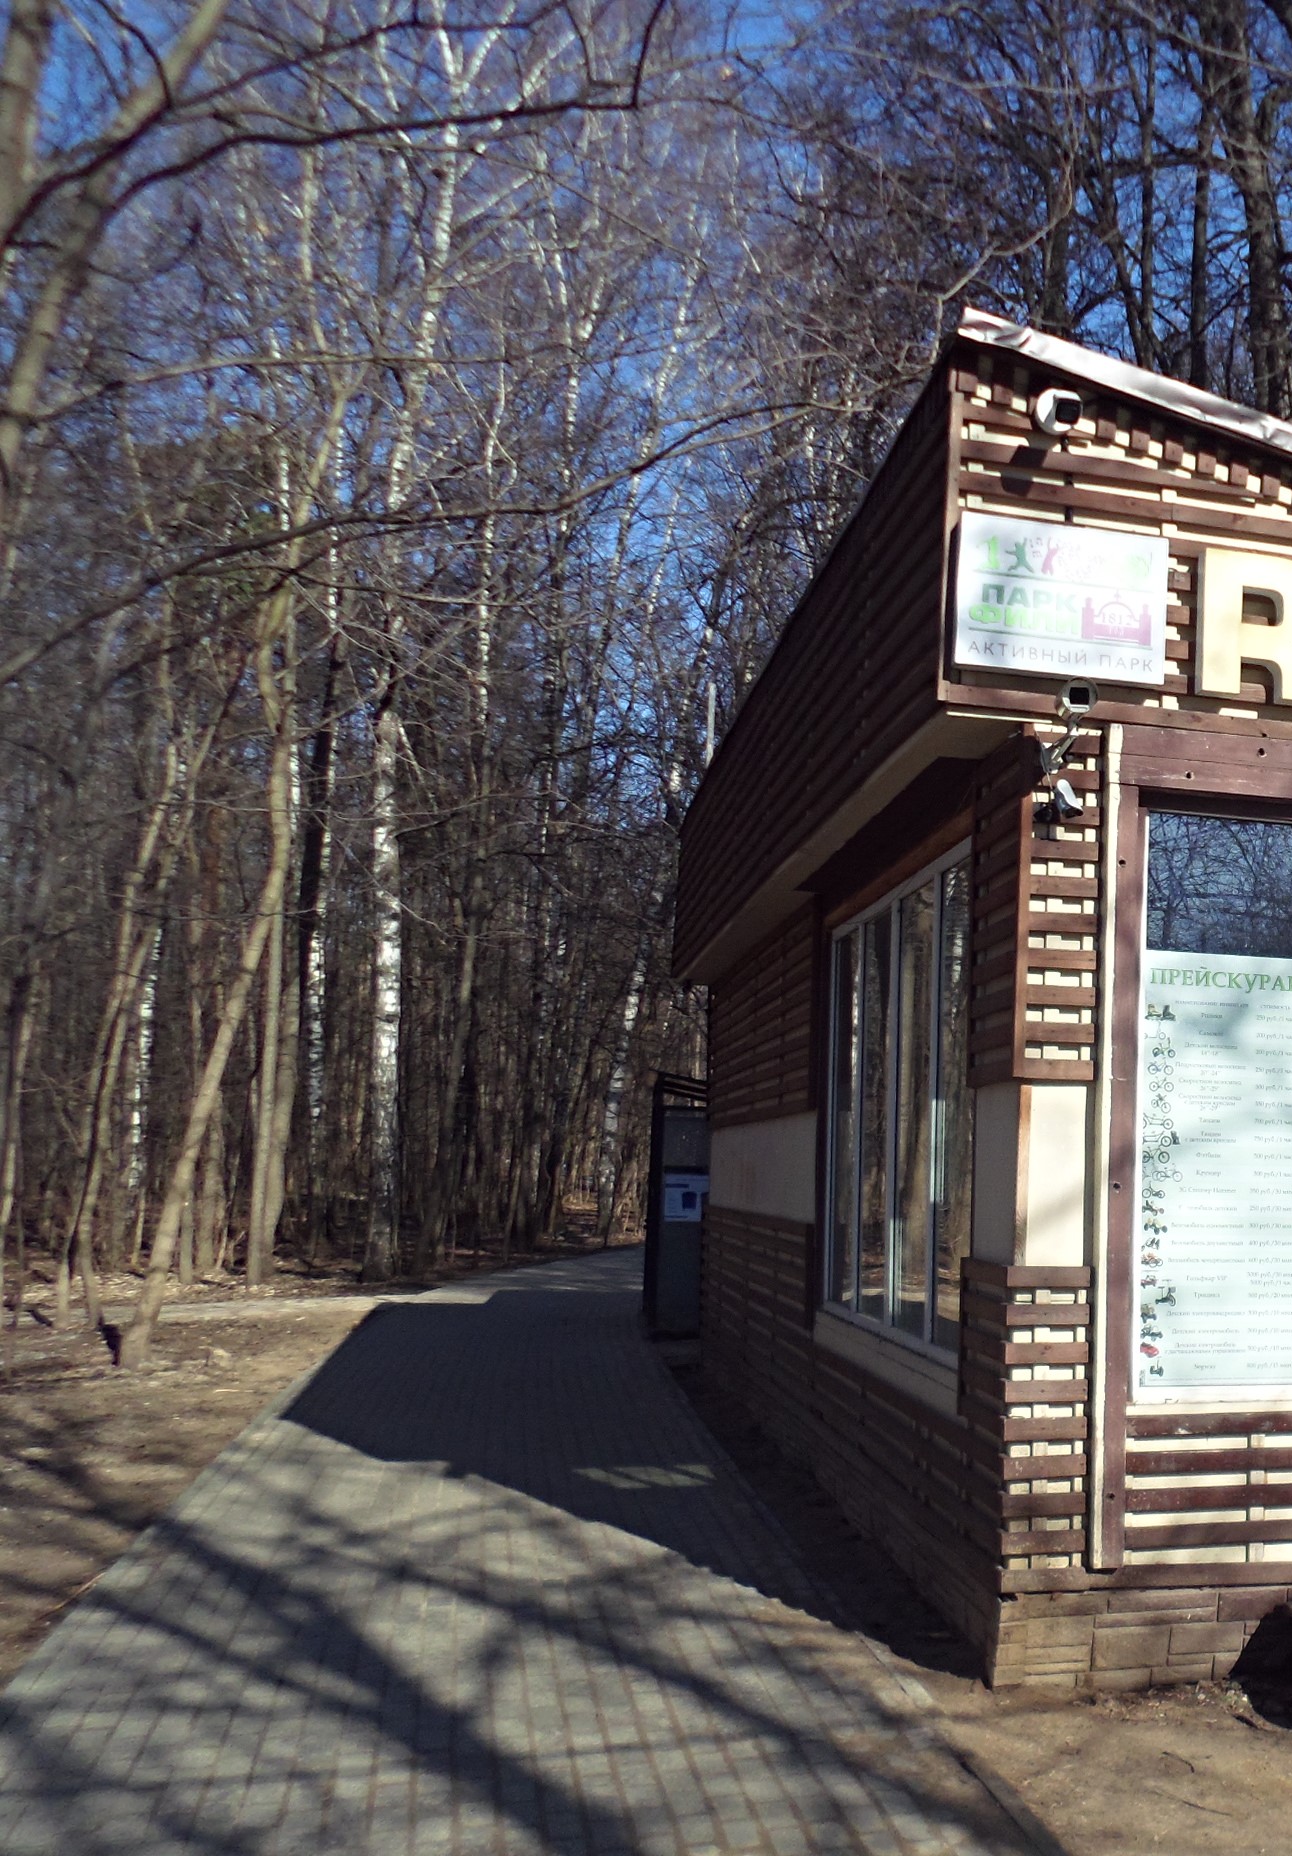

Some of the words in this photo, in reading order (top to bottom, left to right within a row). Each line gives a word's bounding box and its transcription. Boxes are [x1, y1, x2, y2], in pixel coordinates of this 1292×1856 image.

[982, 584, 1077, 612] ПАРК
[968, 603, 1078, 635] ФИЛИ
[1101, 610, 1133, 626] 1812
[968, 640, 1088, 665] АКТИВНЫЙ
[1100, 654, 1154, 672] ПАРК
